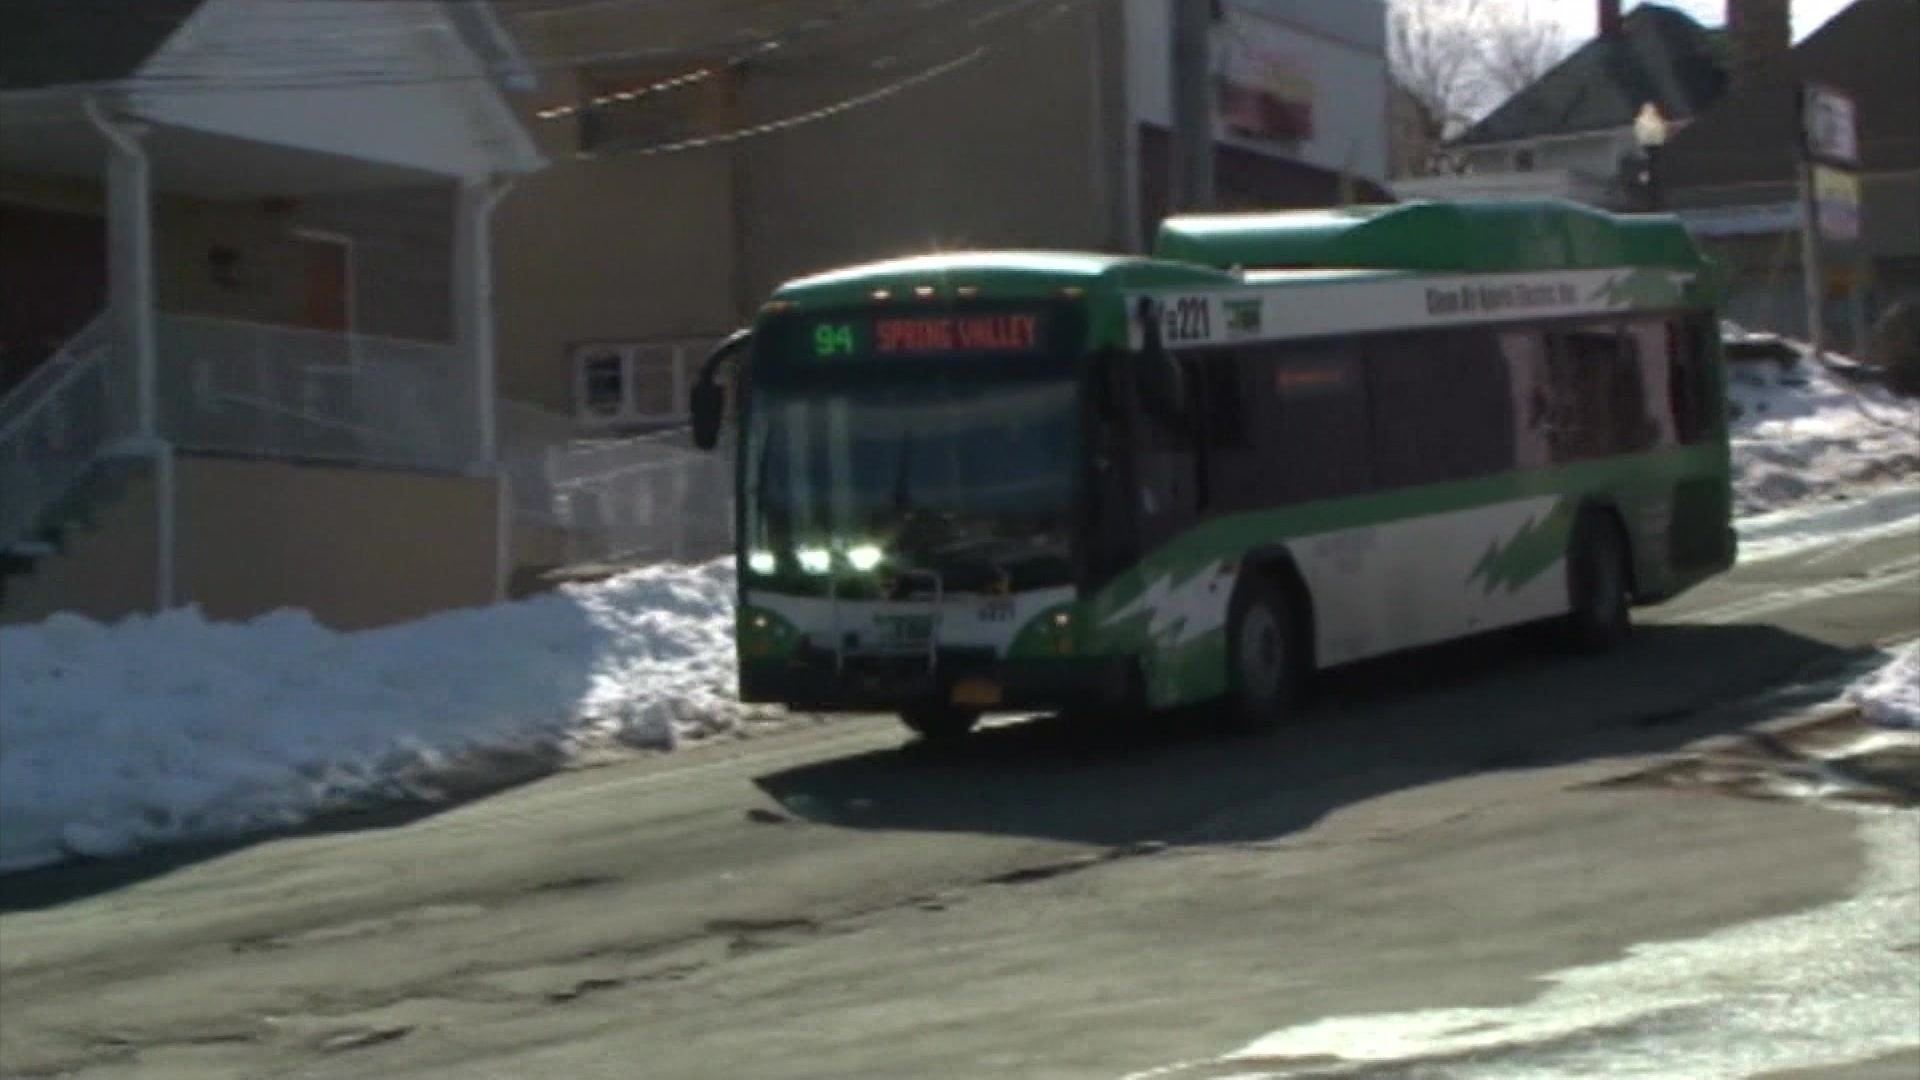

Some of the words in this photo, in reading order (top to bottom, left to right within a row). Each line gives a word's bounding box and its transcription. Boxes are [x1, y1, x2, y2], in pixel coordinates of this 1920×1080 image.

[815, 323, 854, 356] 94
[873, 317, 953, 351] SPRING
[959, 314, 1036, 349] VALLEY
